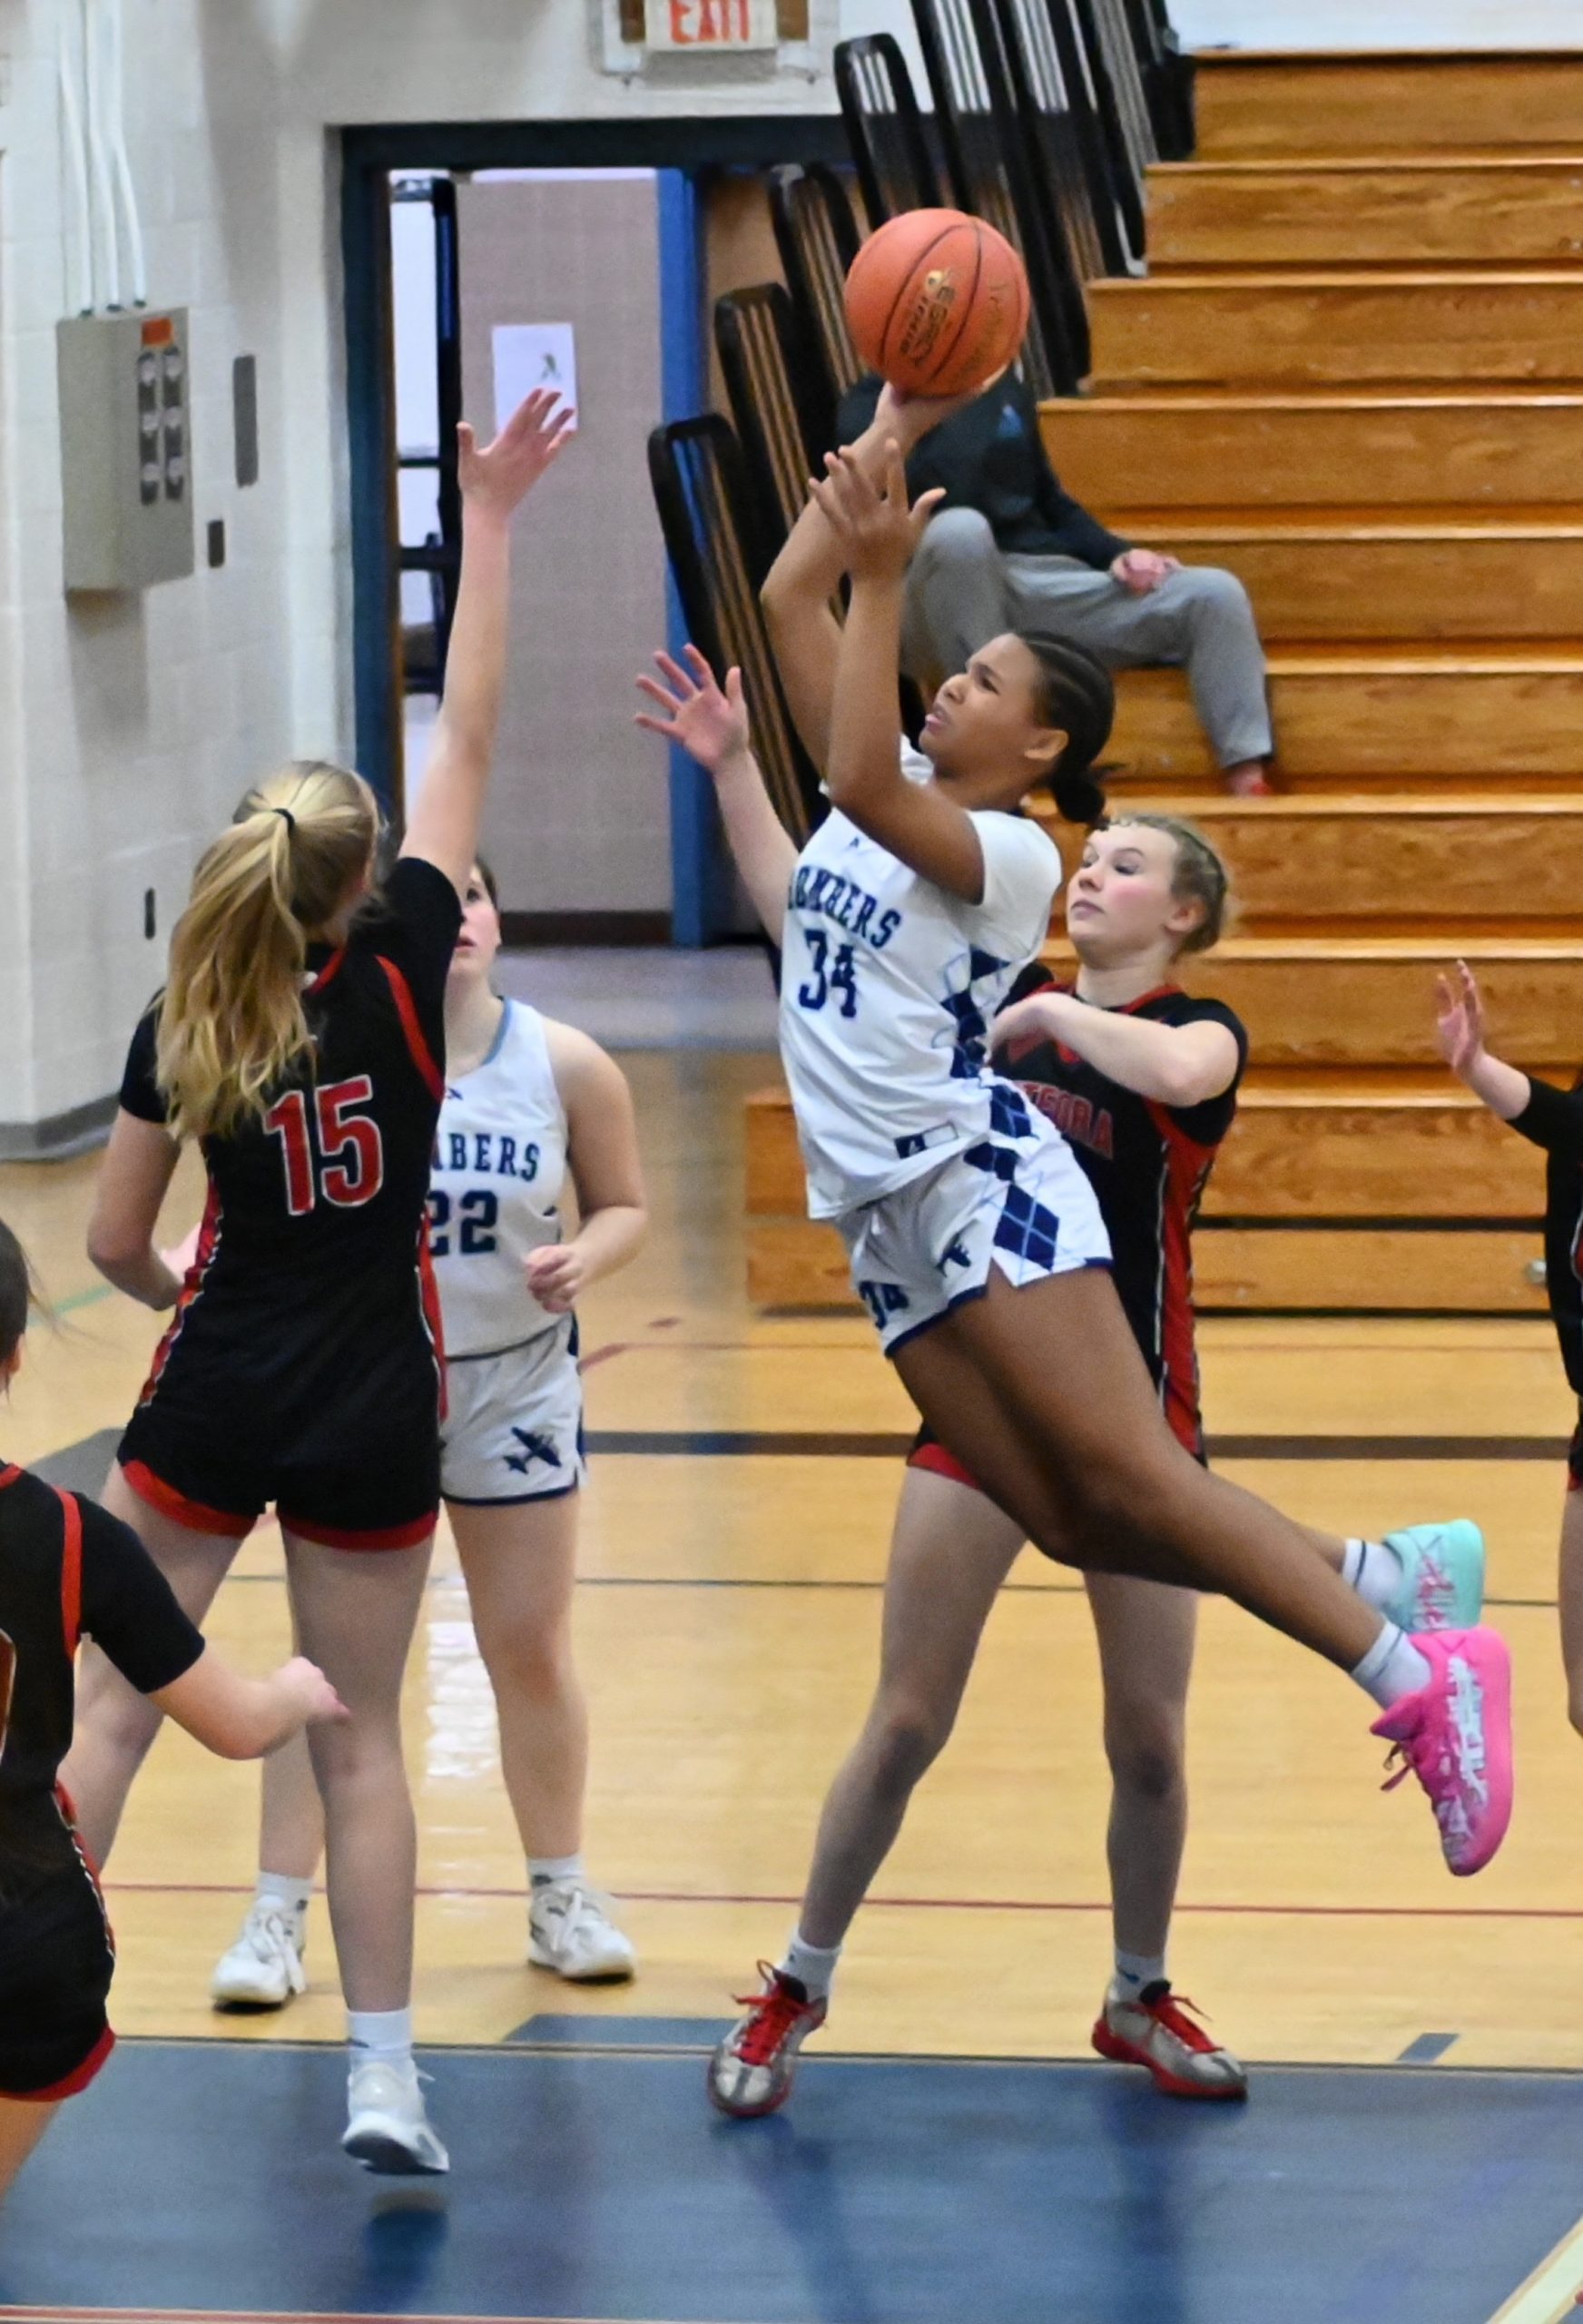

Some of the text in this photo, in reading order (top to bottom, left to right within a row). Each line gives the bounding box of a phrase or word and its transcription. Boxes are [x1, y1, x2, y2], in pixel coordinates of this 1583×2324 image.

[787, 865, 902, 949] OMBERS
[798, 928, 858, 1019] 34
[262, 1073, 384, 1216] 15
[426, 1189, 499, 1257] 22
[858, 1280, 910, 1331] 34
